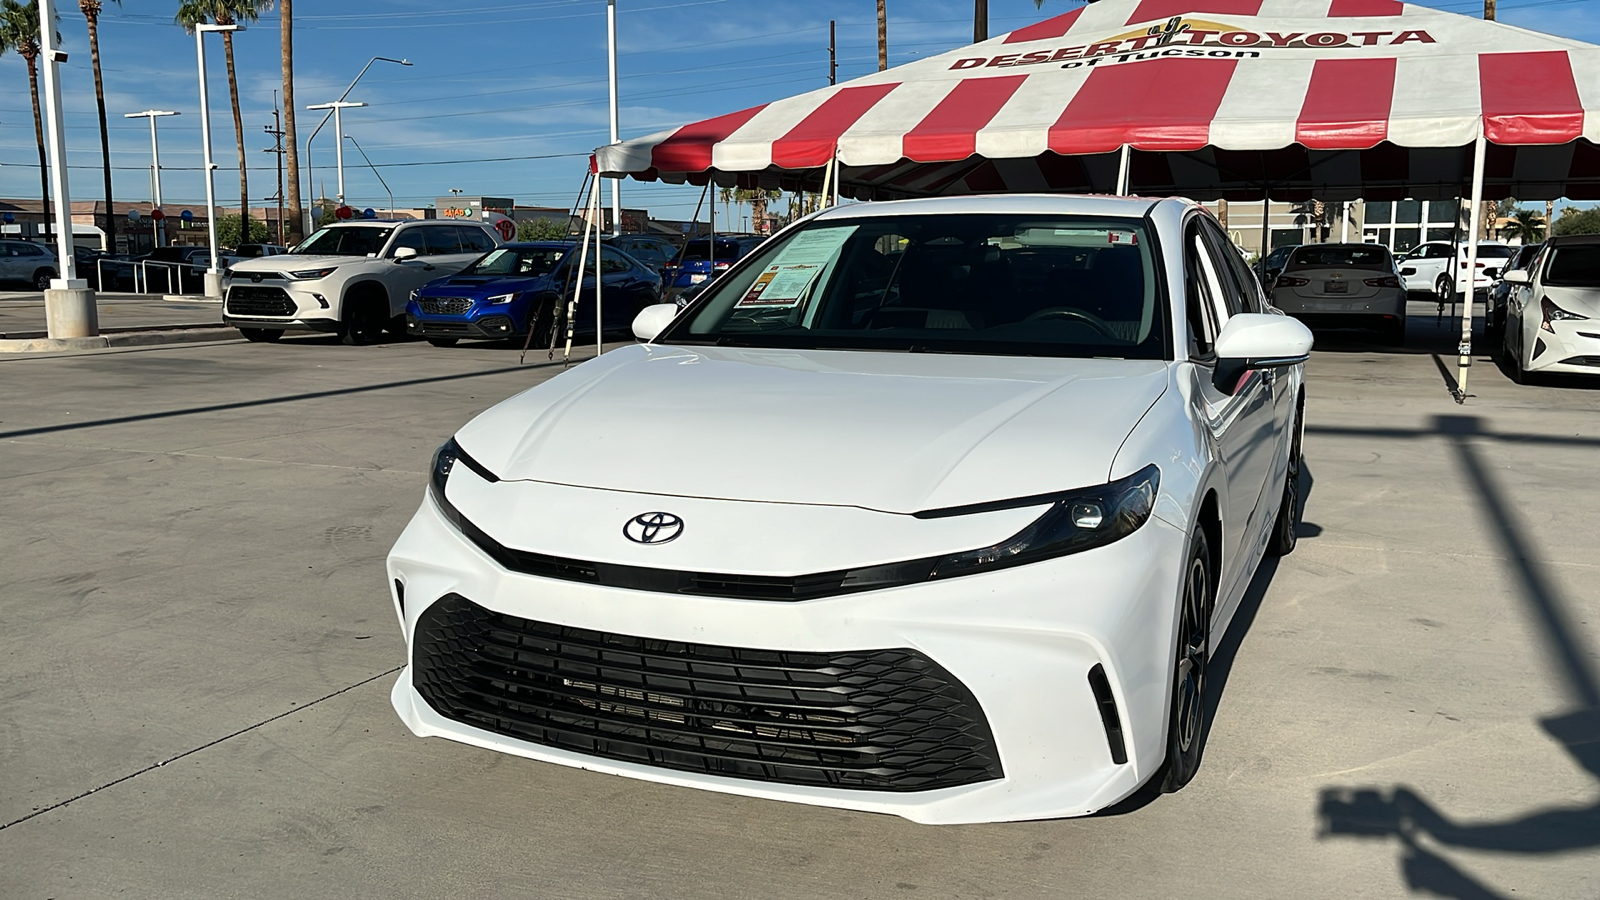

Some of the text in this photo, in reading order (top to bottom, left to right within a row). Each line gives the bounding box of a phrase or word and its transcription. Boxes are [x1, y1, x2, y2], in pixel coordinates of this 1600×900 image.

[948, 29, 1437, 71] DESERT TOYOTA
[1060, 48, 1260, 70] of Tucson
